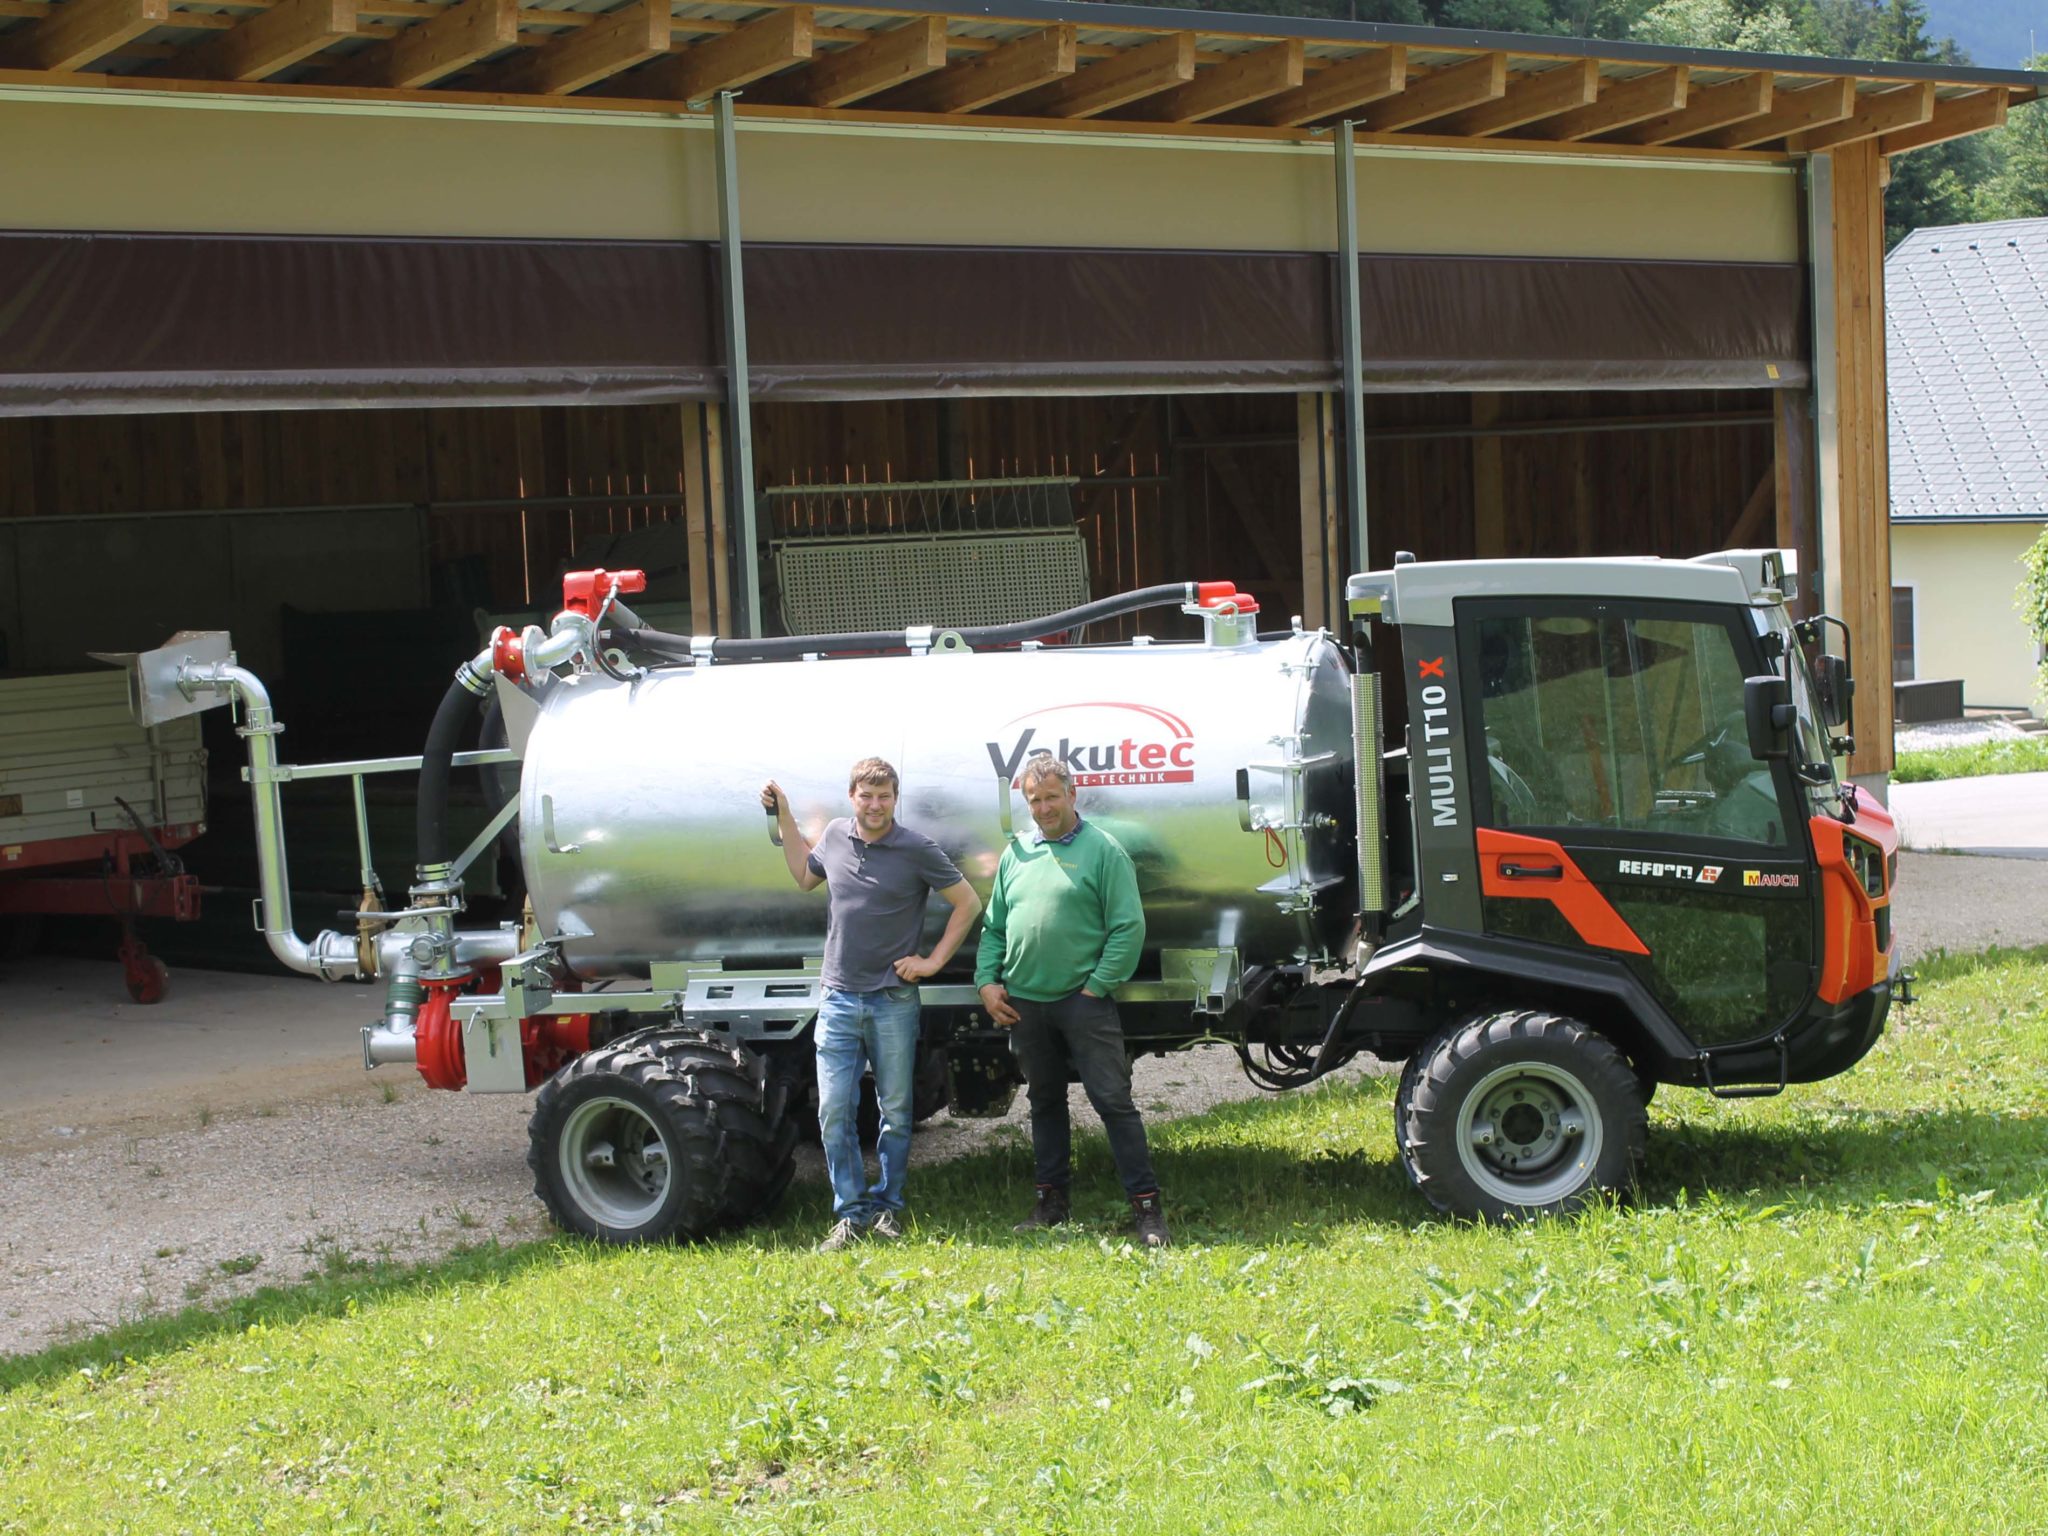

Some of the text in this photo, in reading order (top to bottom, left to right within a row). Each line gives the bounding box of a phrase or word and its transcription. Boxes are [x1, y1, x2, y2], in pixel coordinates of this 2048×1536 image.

[1073, 772, 1166, 786] LE-TECHNIK
[1427, 747, 1458, 827] MULI
[1747, 873, 1800, 887] MAUCH
